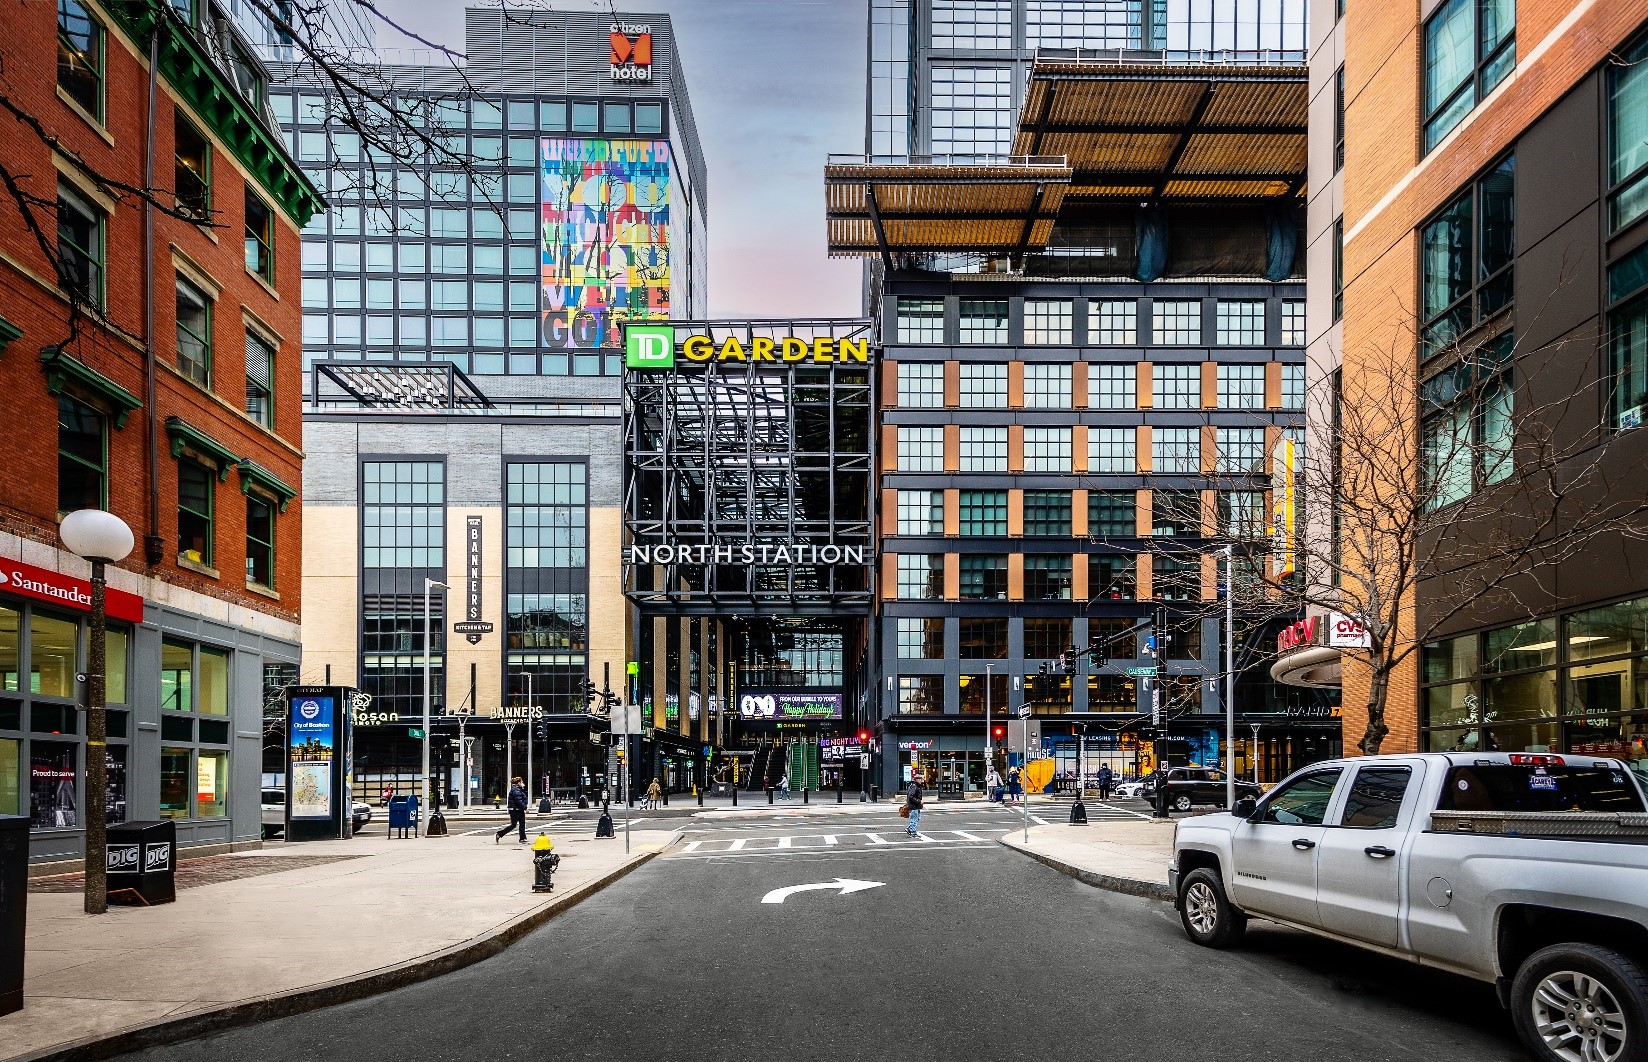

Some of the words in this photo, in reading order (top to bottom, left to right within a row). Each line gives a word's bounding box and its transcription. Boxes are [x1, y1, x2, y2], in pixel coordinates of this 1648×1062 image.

[611, 64, 652, 80] hotel
[630, 333, 670, 360] TD
[683, 335, 868, 363] GARDEN
[631, 544, 733, 564] NORTH
[741, 544, 863, 564] STATION
[470, 528, 479, 618] BANNERS
[12, 571, 92, 606] Santander
[490, 706, 543, 719] BANNERS
[782, 703, 805, 719] Happy
[830, 738, 849, 746] NIGHT
[32, 769, 51, 777] Proud
[51, 769, 58, 777] to
[108, 847, 139, 867] DIG
[147, 846, 170, 866] DIG
